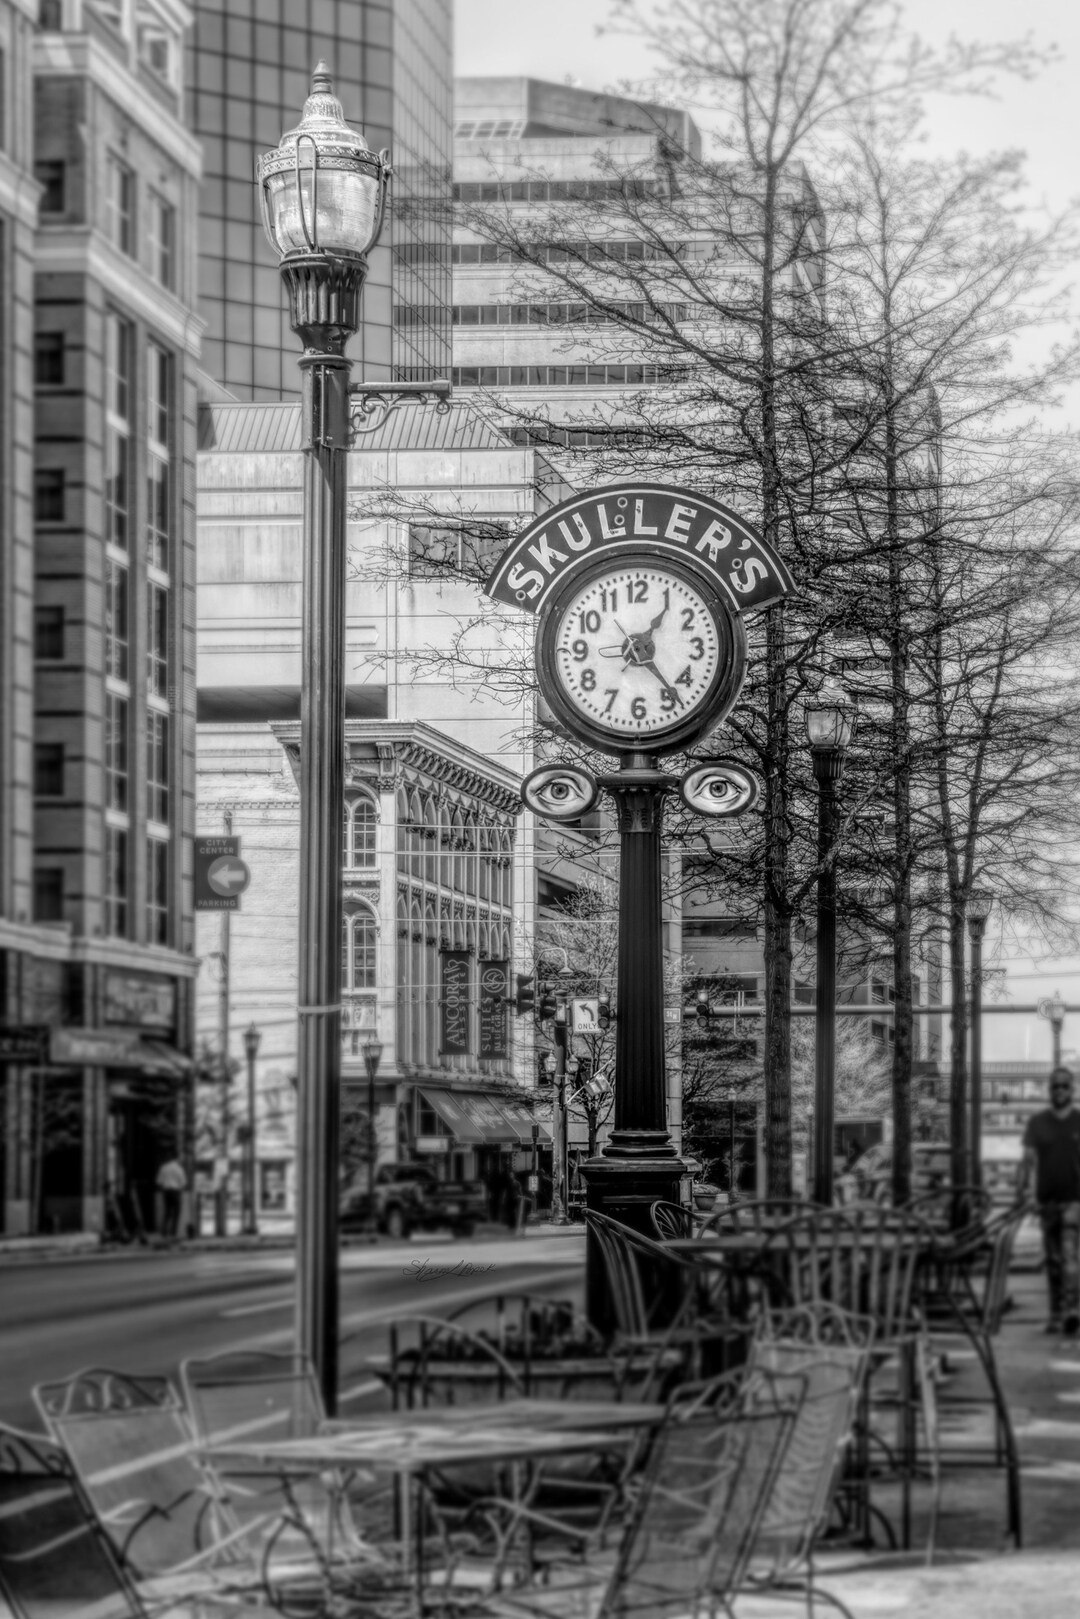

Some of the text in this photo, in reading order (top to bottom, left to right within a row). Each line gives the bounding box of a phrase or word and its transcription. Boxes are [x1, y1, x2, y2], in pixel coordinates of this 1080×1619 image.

[507, 499, 768, 599] SKULLER'S
[600, 588, 618, 612] 11
[625, 580, 649, 603] 12
[662, 587, 671, 609] 1
[579, 609, 601, 633] 10
[680, 608, 695, 631] 2
[572, 639, 589, 662] 9
[688, 637, 705, 660] 3
[580, 668, 597, 692] 8
[675, 665, 694, 687] 4
[604, 689, 619, 713] 7
[630, 697, 647, 720] 6
[660, 688, 677, 712] 5
[446, 973, 460, 1046] ANCORA
[481, 996, 492, 1051] SUITES
